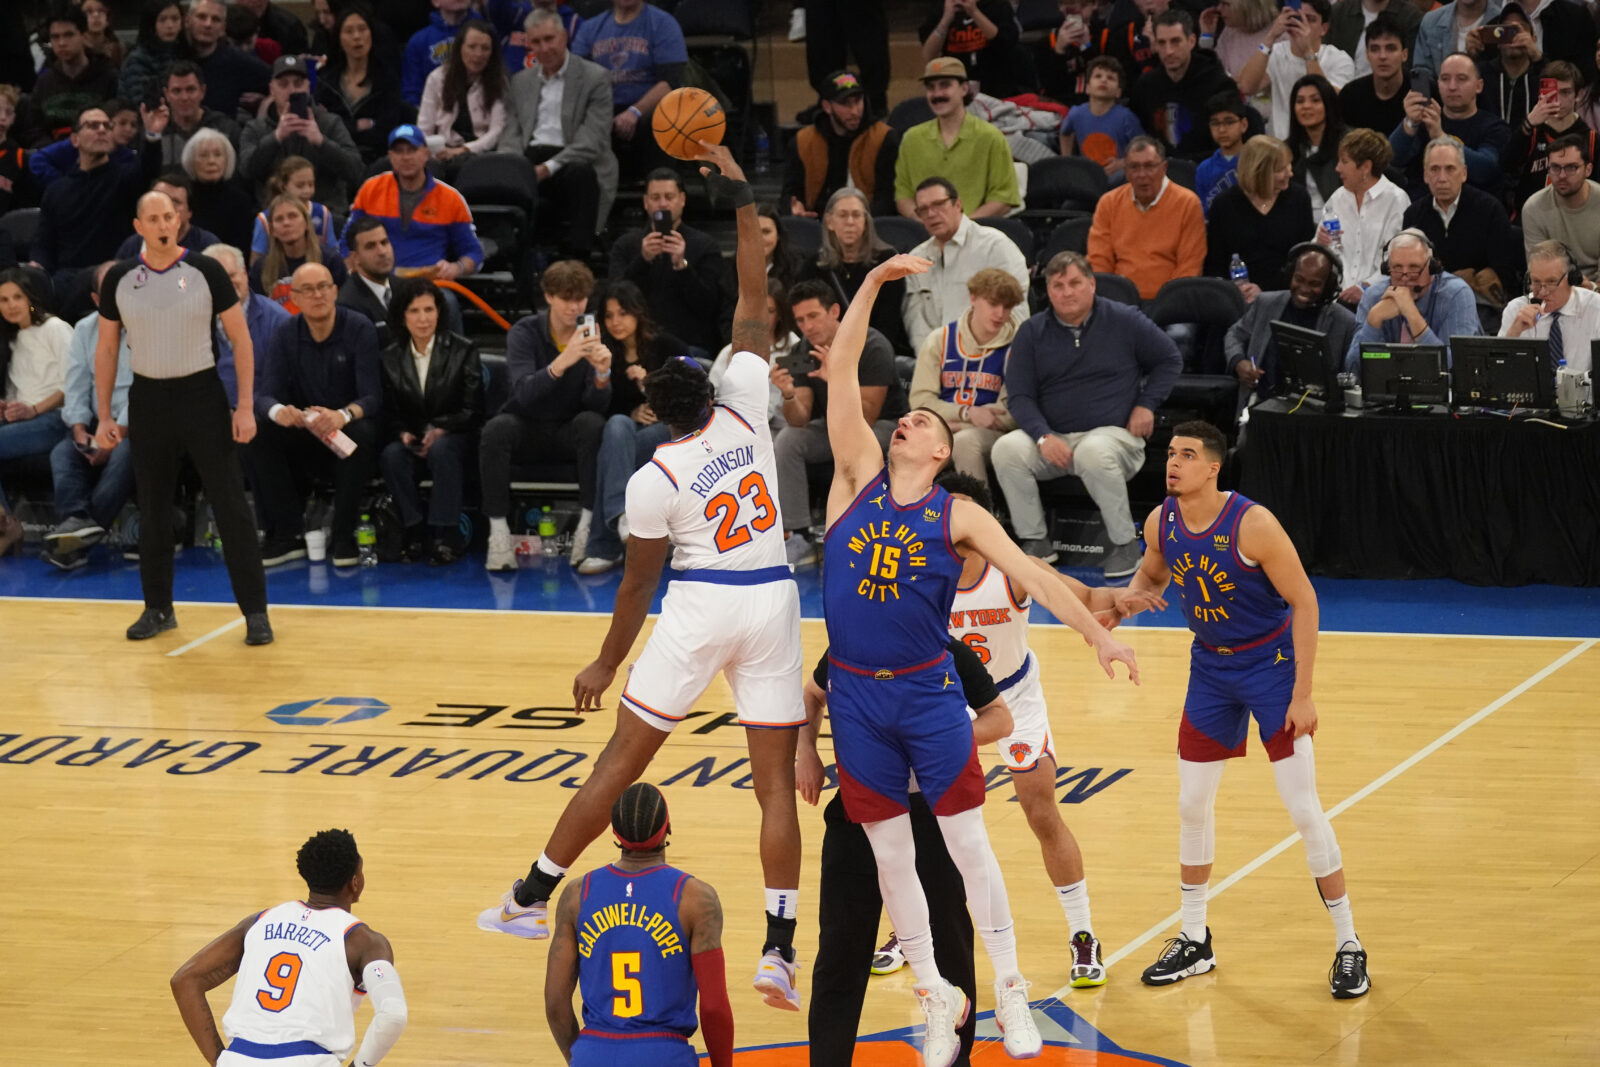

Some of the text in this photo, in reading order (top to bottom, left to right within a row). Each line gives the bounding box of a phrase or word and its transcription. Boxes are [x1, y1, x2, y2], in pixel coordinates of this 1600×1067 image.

[1530, 157, 1549, 173] NE
[690, 445, 754, 499] ROBINSON
[703, 470, 777, 554] 23
[925, 507, 941, 518] WU
[1168, 512, 1175, 522] 6
[848, 521, 927, 567] MILE HIGH
[1052, 540, 1105, 554] lliman.com
[1213, 534, 1230, 544] WU
[869, 543, 902, 580] 15
[1172, 552, 1236, 592] MILE HIGH
[857, 578, 901, 602] CITY
[1196, 576, 1211, 603] 1
[966, 607, 1011, 627] YORK
[1194, 605, 1230, 622] CITY
[961, 633, 992, 665] 6
[0, 733, 263, 775] GARD
[264, 922, 331, 951] BARRETT
[578, 902, 684, 959] CALDWELL-POPE
[255, 951, 303, 1013] 9
[611, 952, 643, 1019] 5
